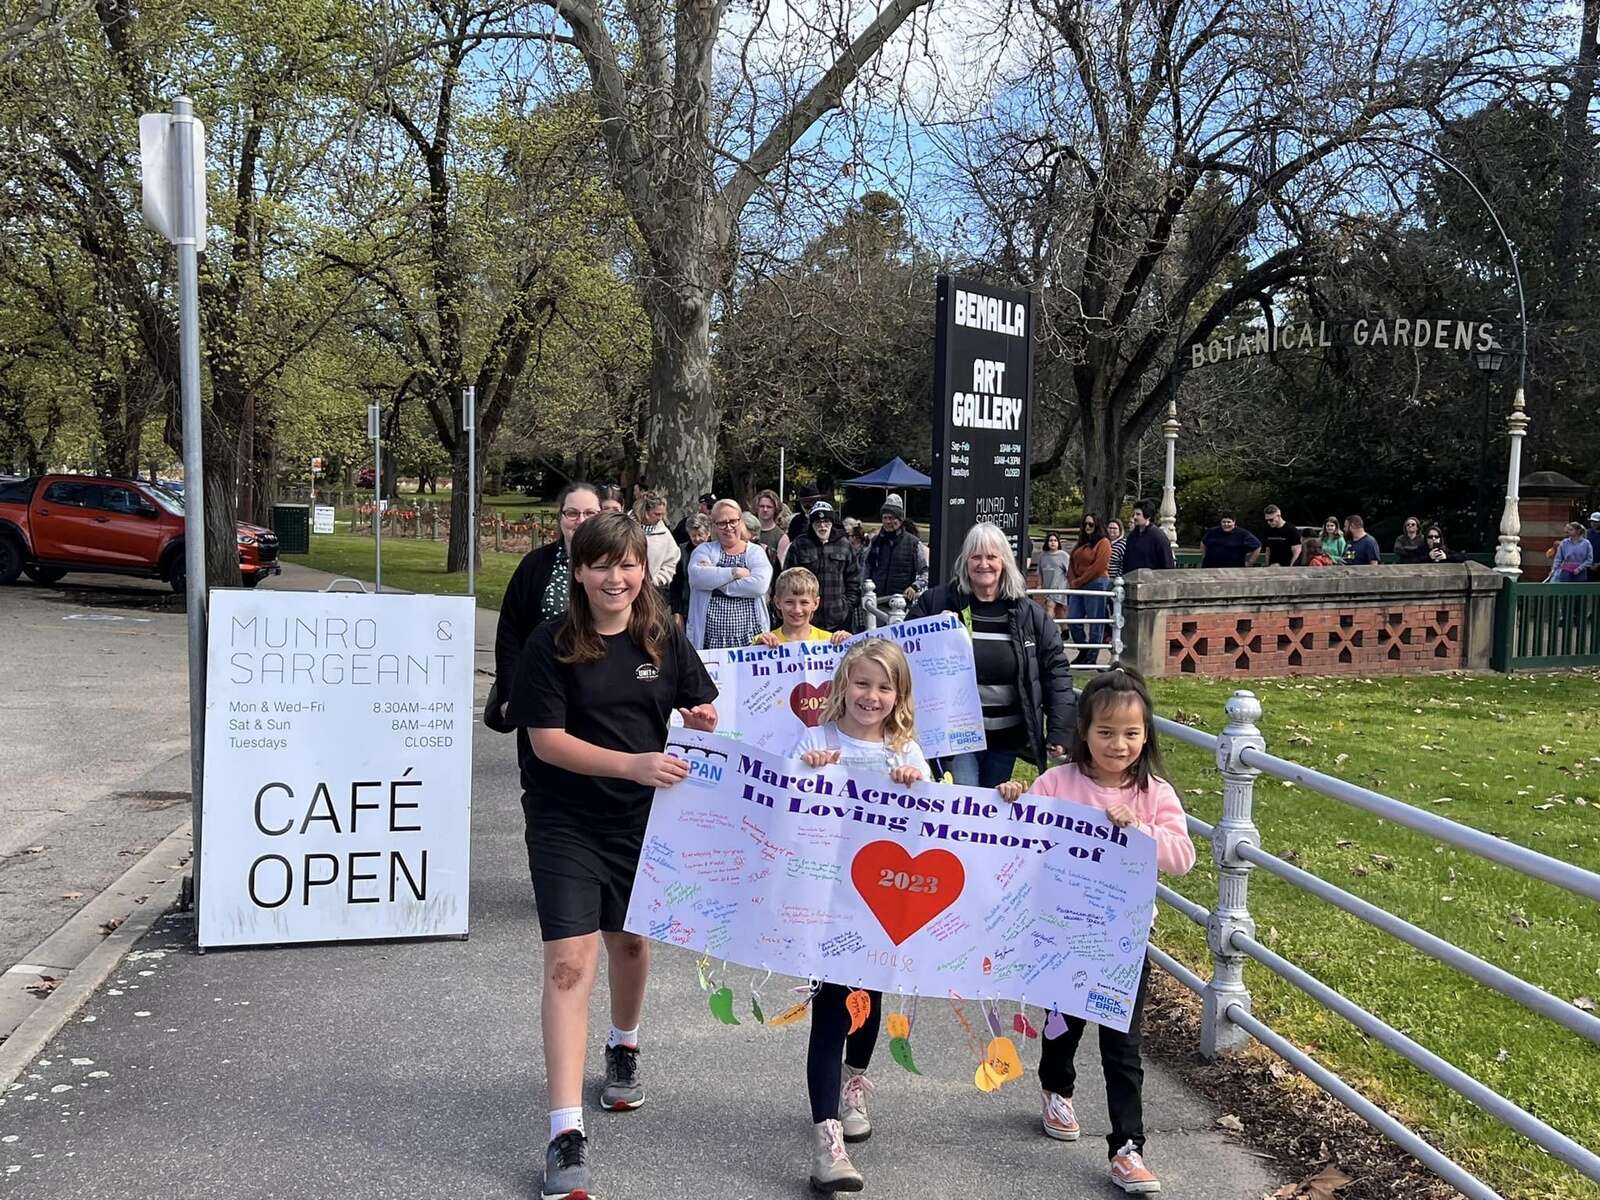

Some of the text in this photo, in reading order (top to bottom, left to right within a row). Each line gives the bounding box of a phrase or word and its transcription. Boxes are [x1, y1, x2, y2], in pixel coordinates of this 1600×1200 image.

[955, 289, 1025, 337] BENALLA
[1191, 318, 1494, 368] BOTANICAL GARDENS
[973, 359, 1006, 394] ART
[952, 391, 1023, 430] GALLERY
[975, 496, 1005, 514] MUNRO
[231, 616, 453, 649] MUNRO &
[727, 644, 792, 664] March
[752, 663, 771, 677] In
[776, 657, 834, 675] Loving
[230, 652, 455, 685] SARGEANT
[229, 701, 258, 713] Mon
[260, 701, 271, 713] &
[229, 718, 251, 731] Sat
[252, 719, 263, 731] &
[266, 718, 291, 730] Sun
[950, 729, 978, 741] BRICK
[229, 736, 453, 751] Tuesdays CLOSED
[956, 735, 984, 746] BRICK
[253, 766, 423, 837] CAFÉ
[736, 754, 1129, 849] March Across the Monash
[742, 784, 1106, 864] In Loving Memory of
[248, 849, 428, 909] OPEN
[877, 868, 939, 895] 2023
[1088, 992, 1122, 1008] BRICK
[1095, 1001, 1128, 1017] BRICK
